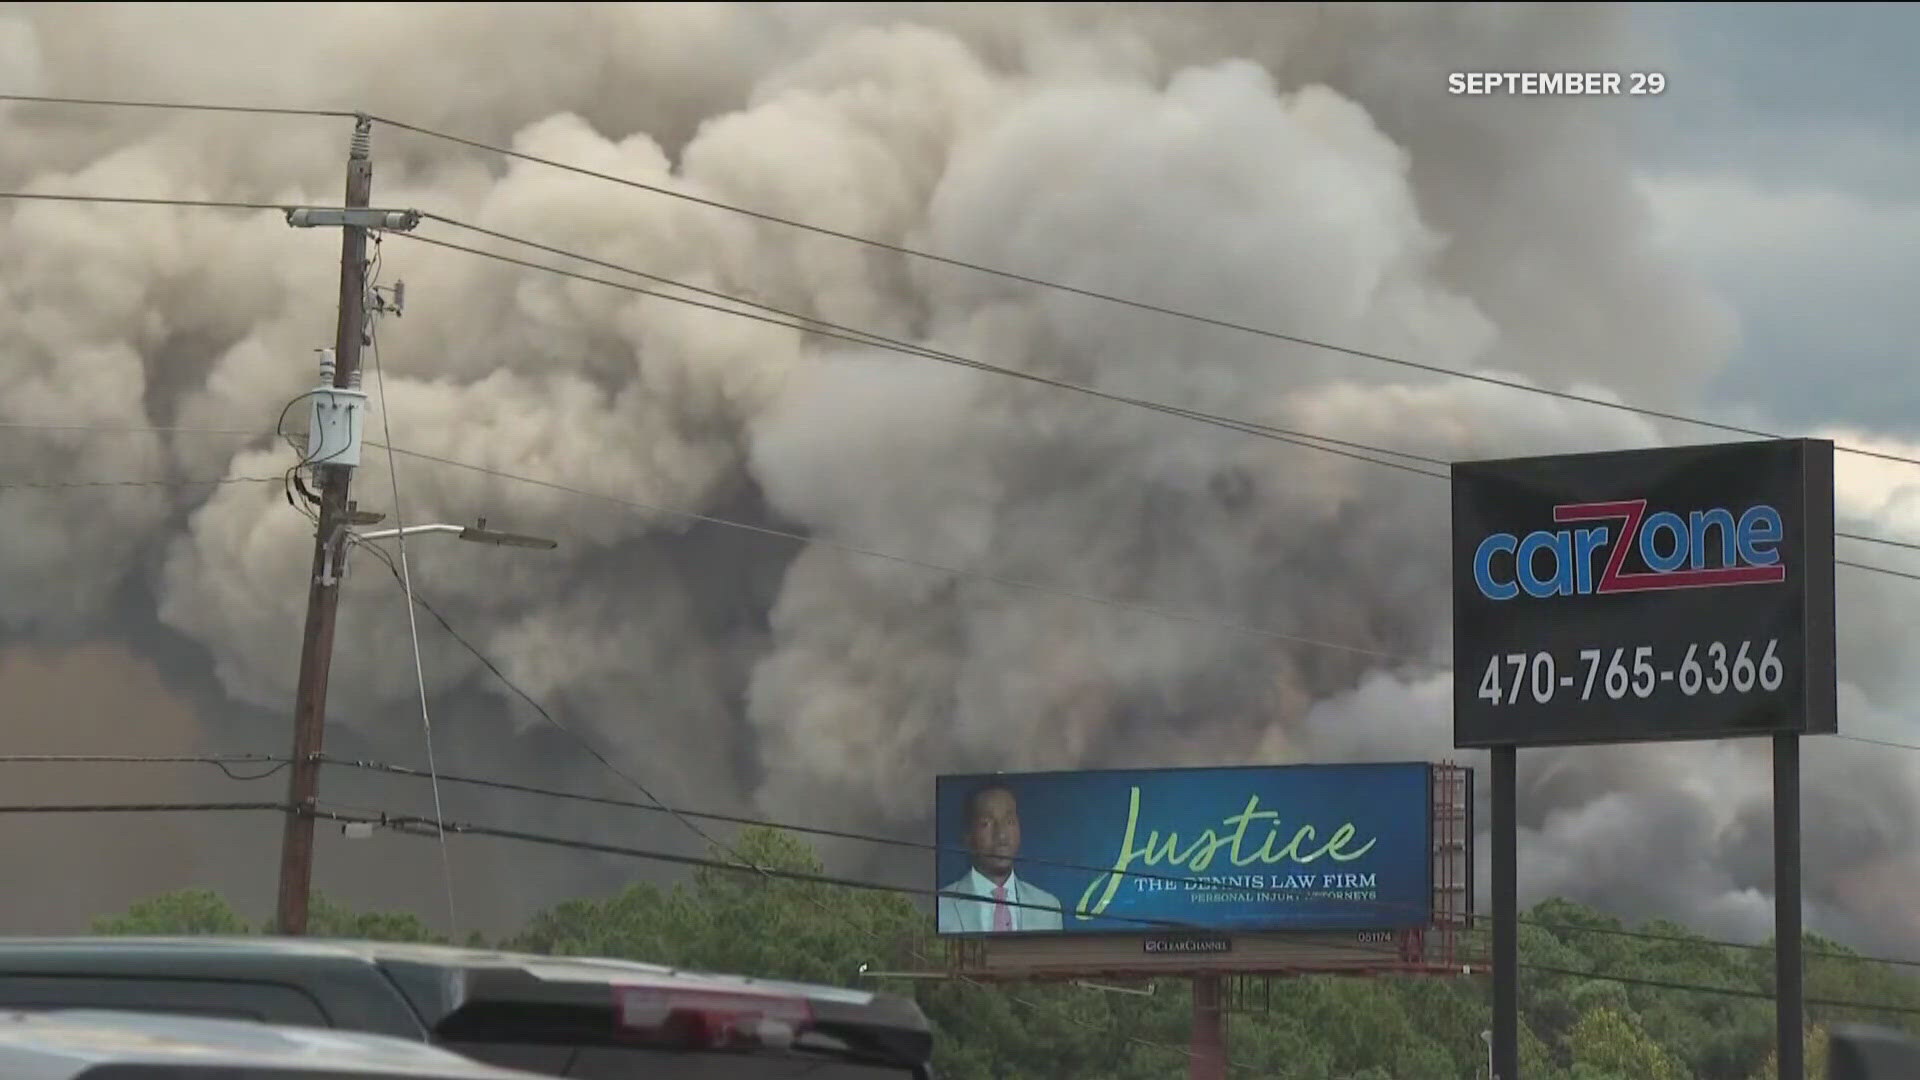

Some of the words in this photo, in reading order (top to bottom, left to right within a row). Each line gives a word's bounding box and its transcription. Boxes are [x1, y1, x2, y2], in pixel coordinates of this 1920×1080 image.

[1473, 500, 1785, 600] carZone
[1478, 639, 1784, 706] 470-765-6366
[1075, 786, 1377, 920] Justice
[1135, 877, 1177, 892] THE
[1183, 874, 1264, 890] DENNIS
[1271, 874, 1316, 888] LAW
[1323, 873, 1376, 888] FIRM
[1191, 893, 1254, 903] PERSONAL
